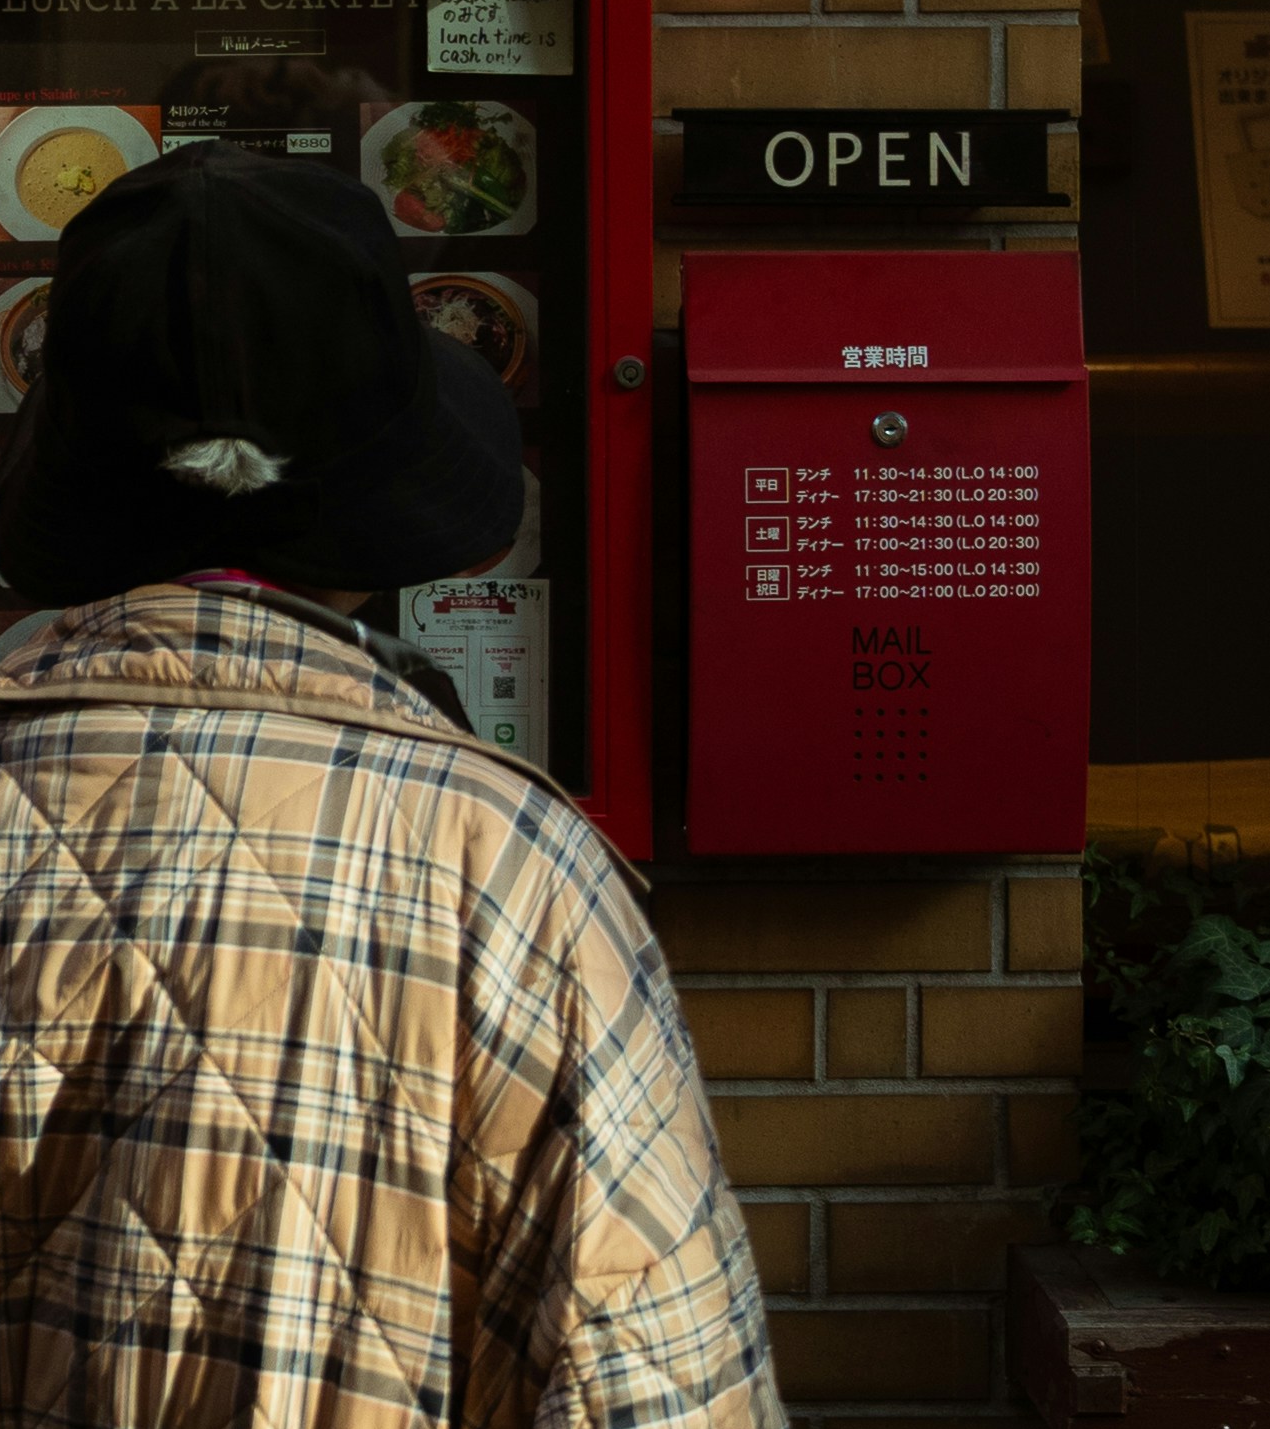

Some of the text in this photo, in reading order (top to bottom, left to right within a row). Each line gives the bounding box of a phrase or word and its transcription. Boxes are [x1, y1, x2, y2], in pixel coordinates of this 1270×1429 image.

[440, 26, 489, 45] lunch
[439, 46, 481, 64] cash
[167, 104, 230, 118] 本日のスープ
[289, 137, 330, 148] ¥880
[764, 130, 971, 188] OPEN
[841, 345, 929, 369] 営業時間
[795, 467, 832, 482] ランチ
[754, 478, 779, 492] 平日
[795, 489, 840, 504] ディナー
[796, 515, 833, 530] ランチ
[755, 526, 780, 541] 土曜
[796, 538, 845, 552] ディナー
[756, 568, 780, 582] 日曜
[796, 564, 833, 579] ランチ
[755, 582, 780, 597] 祝日
[796, 586, 845, 600] ディナー
[852, 626, 932, 655] MAIL
[852, 661, 931, 690] BOX
